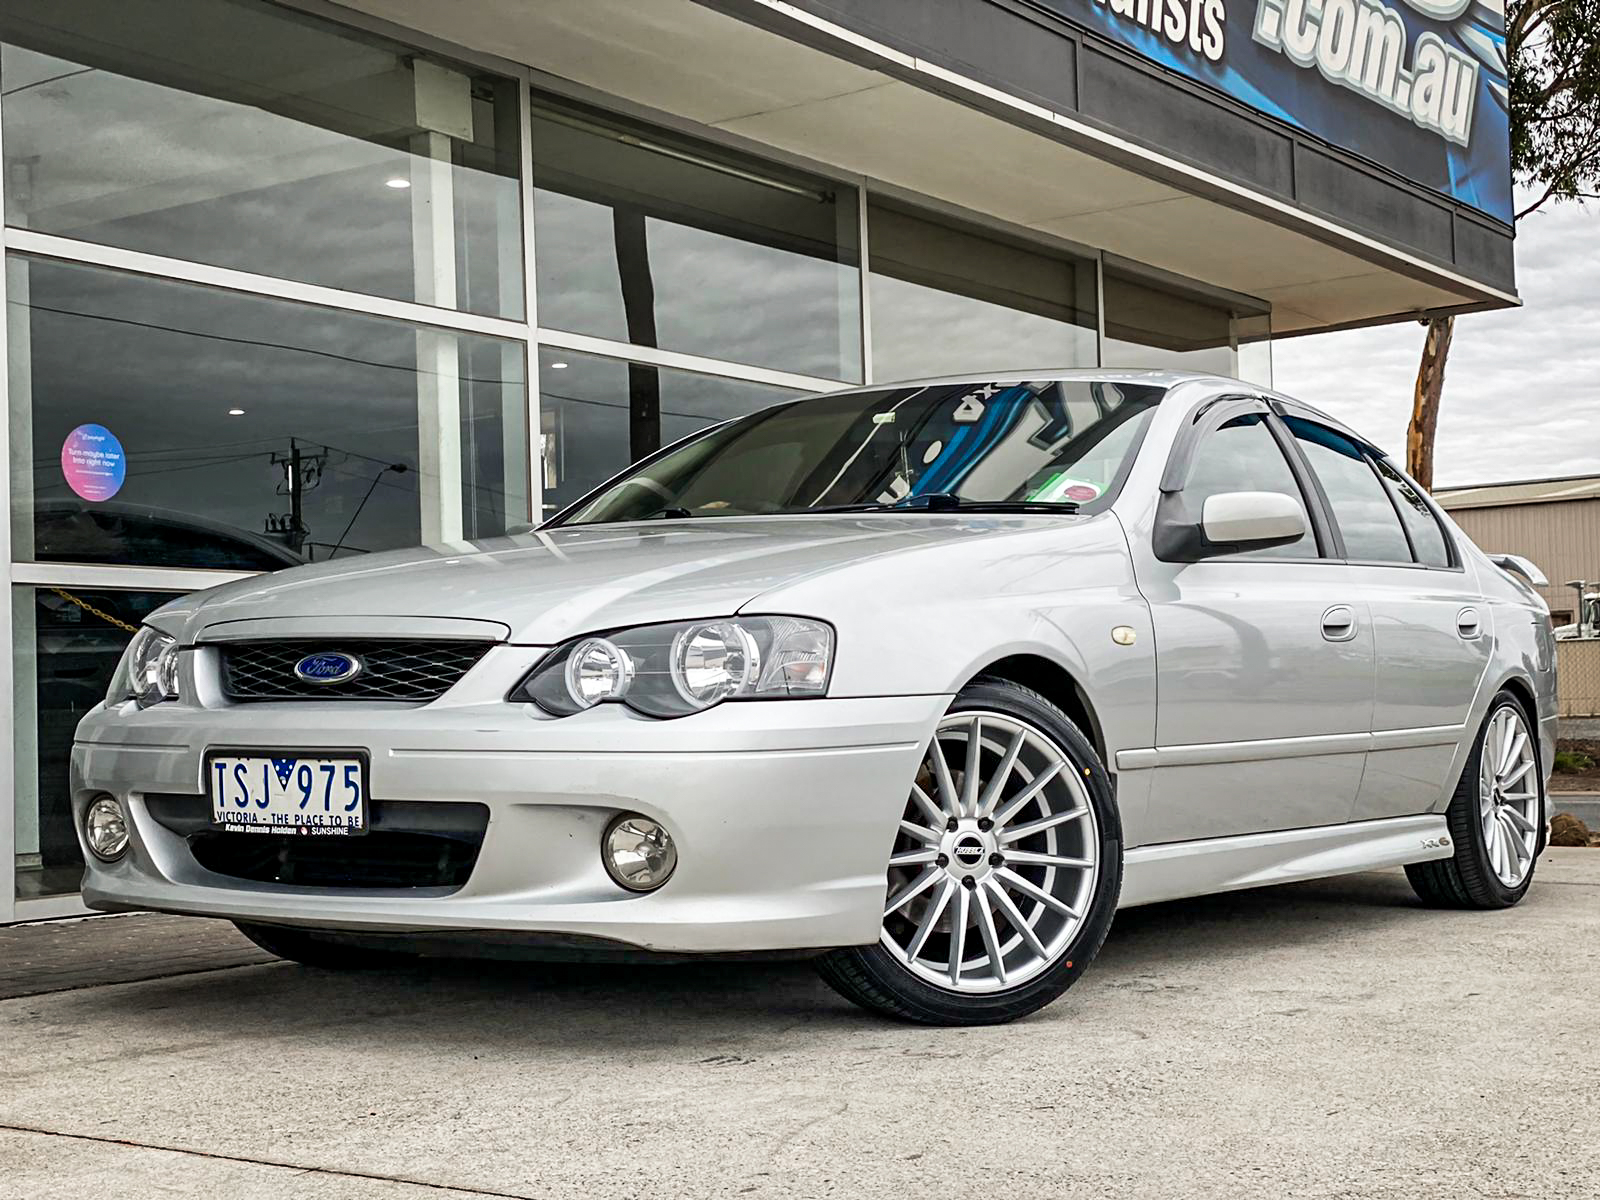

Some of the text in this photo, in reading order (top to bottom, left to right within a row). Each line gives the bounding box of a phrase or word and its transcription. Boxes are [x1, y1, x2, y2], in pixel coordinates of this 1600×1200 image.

[1253, 0, 1478, 146] .com.au
[83, 450, 105, 459] maybe
[105, 451, 120, 460] later
[86, 457, 101, 467] right
[305, 656, 343, 676] Ford
[214, 762, 360, 812] TSJ 975
[217, 811, 258, 824] VICTORIA
[271, 813, 289, 824] THE
[294, 814, 324, 826] PLACE
[328, 815, 343, 827] TO
[347, 816, 360, 828] BE
[225, 823, 244, 833] Kevin
[271, 826, 297, 835] Holden
[311, 826, 349, 836] SUNSHINE
[1420, 836, 1450, 849] XR6
